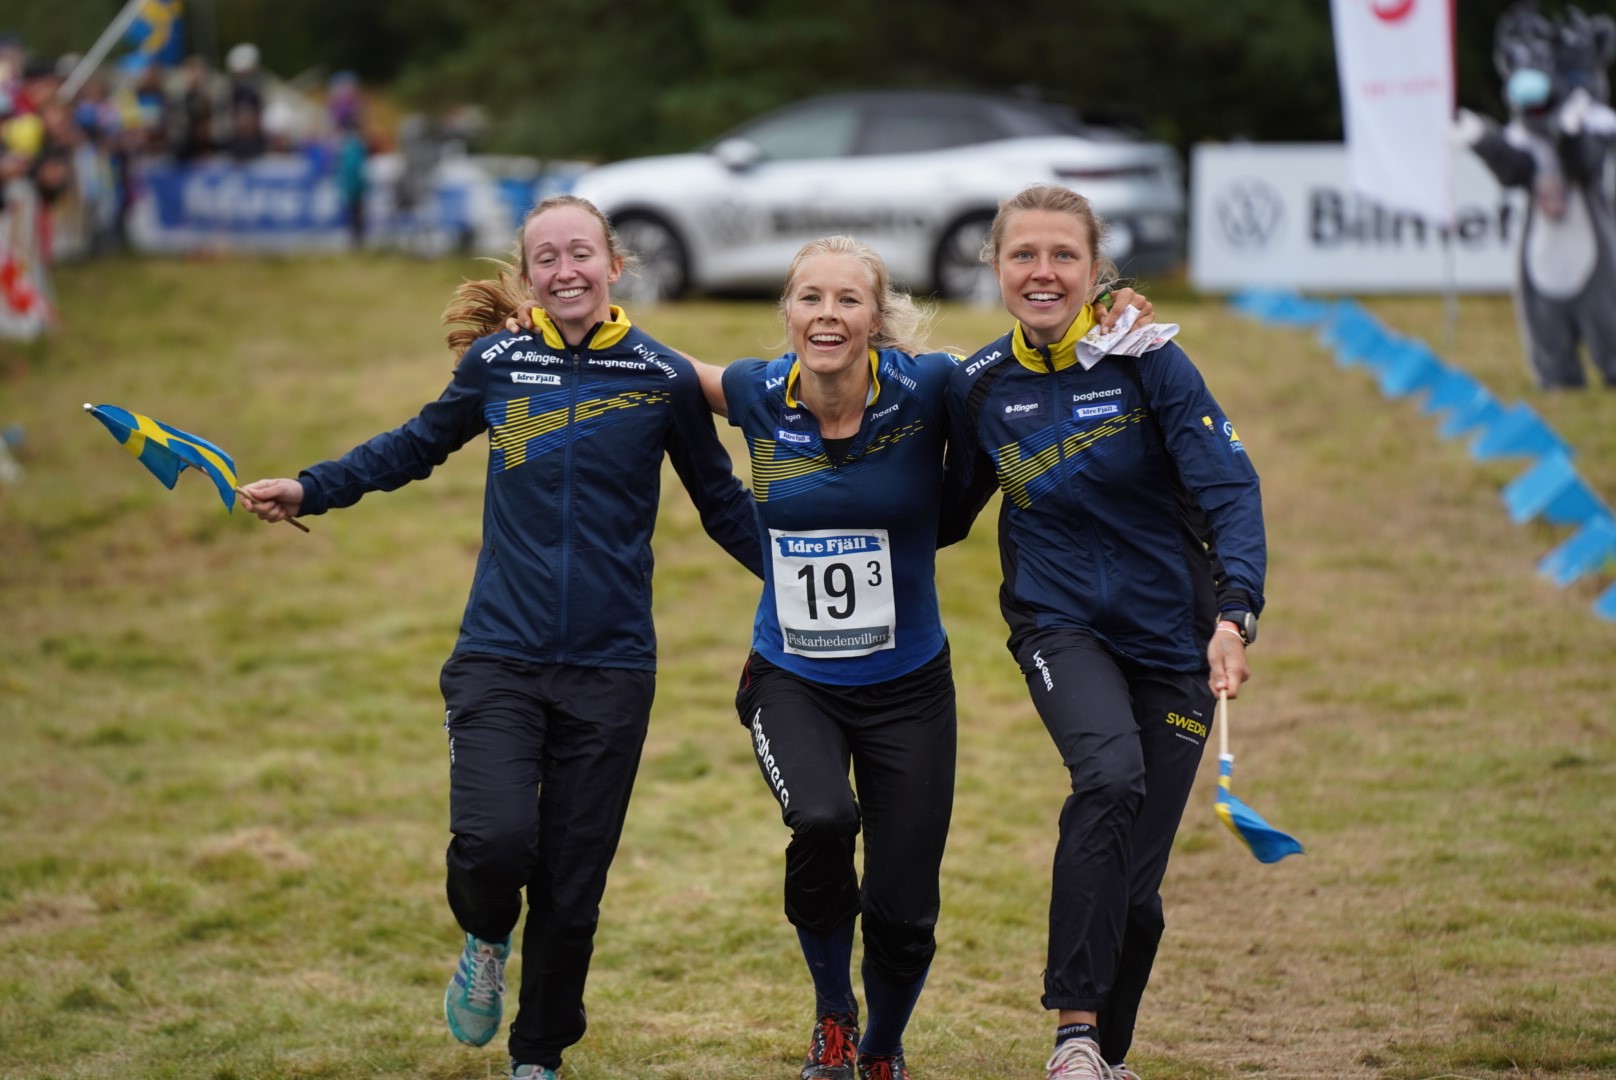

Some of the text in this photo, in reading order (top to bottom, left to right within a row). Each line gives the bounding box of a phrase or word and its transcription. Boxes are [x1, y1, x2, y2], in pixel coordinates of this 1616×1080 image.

[1309, 186, 1516, 246] Bilmet
[965, 350, 1002, 377] SILVA
[1073, 387, 1122, 402] bagheera
[787, 537, 867, 554] Idre Fjäll
[797, 560, 882, 620] 19 3
